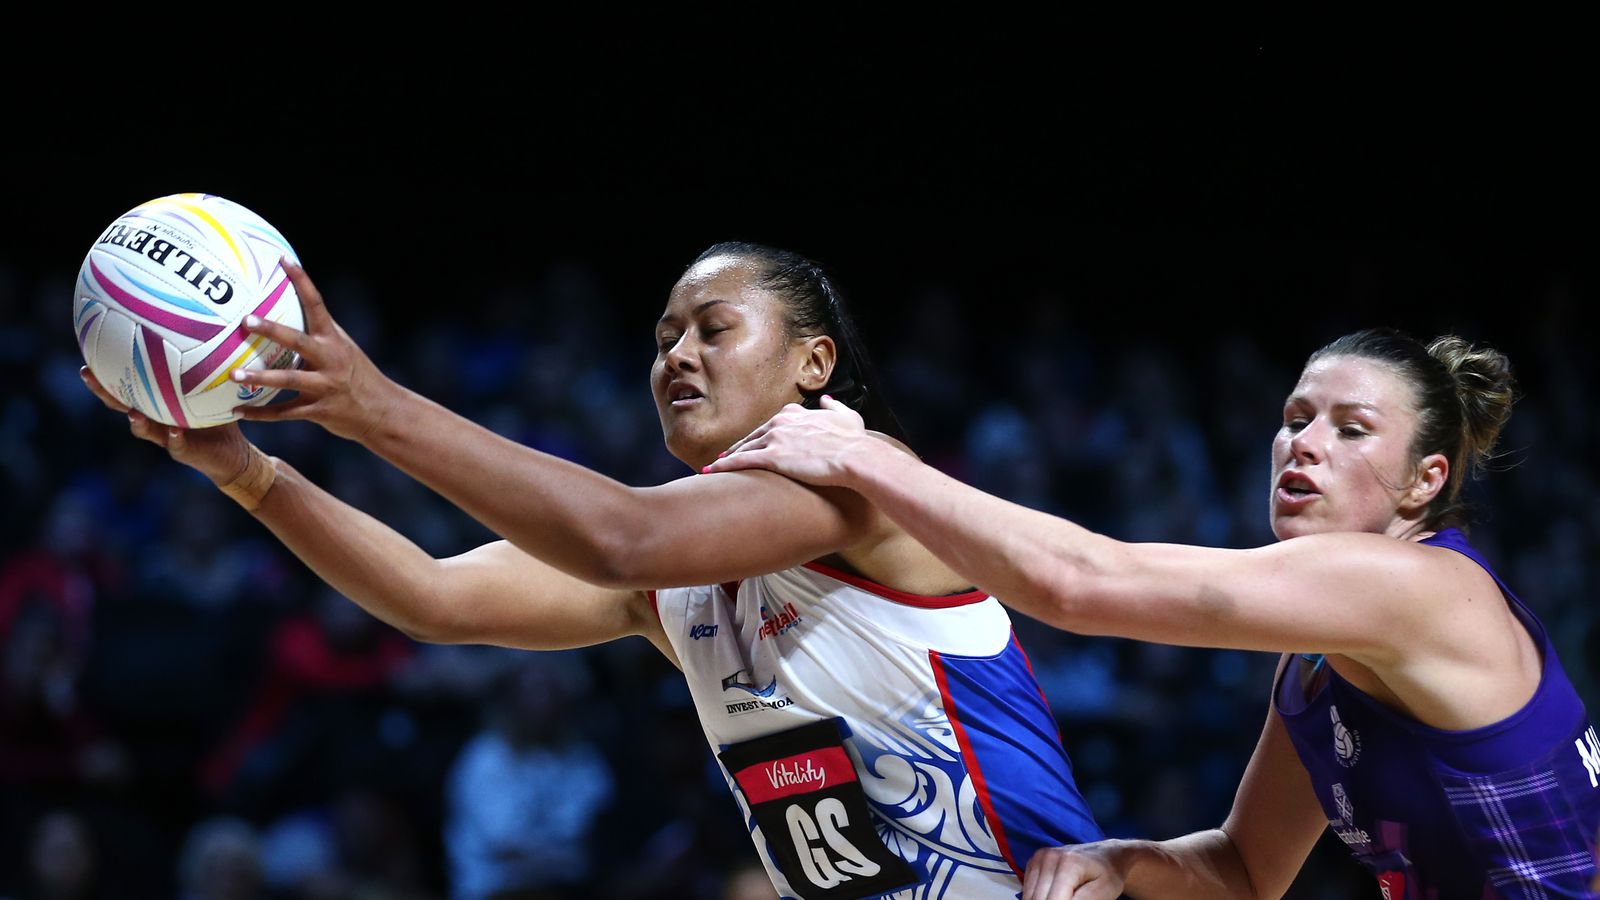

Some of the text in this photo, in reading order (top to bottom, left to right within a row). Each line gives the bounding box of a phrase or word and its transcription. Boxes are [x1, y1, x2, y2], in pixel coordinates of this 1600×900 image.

[98, 224, 234, 305] GILBERT
[726, 700, 760, 714] INVEST
[765, 759, 826, 789] Vitality
[785, 797, 881, 889] GS
